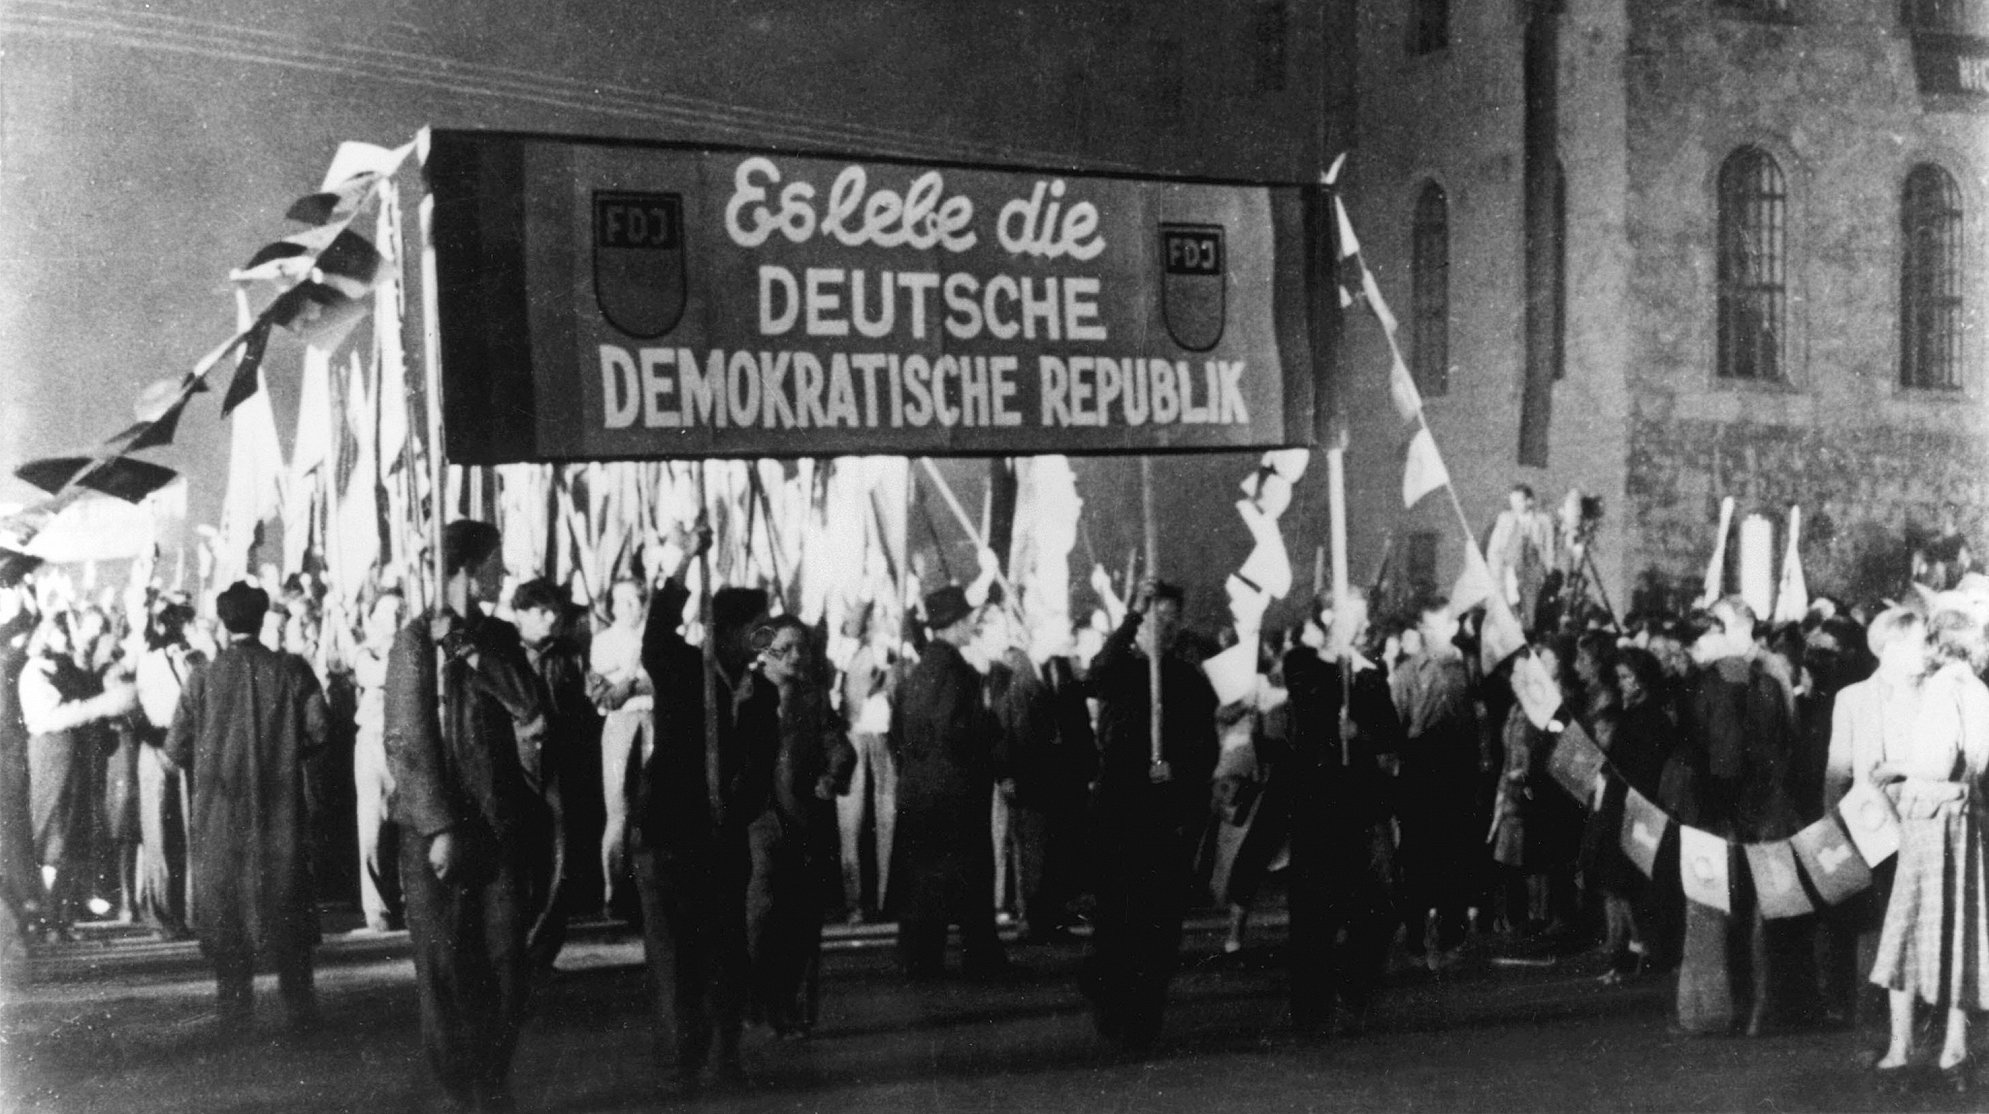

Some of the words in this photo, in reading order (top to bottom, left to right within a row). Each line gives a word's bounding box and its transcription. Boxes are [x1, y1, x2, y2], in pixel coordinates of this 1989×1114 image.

[606, 204, 668, 246] FDJ
[725, 156, 817, 248] Es
[820, 164, 978, 253] lebe
[996, 178, 1107, 261] die
[1168, 237, 1215, 270] FDJ
[758, 264, 1108, 340] DEUTSCHE
[599, 343, 1023, 430] DEMOKRATISCHE
[1038, 354, 1250, 428] REPUBLIK
